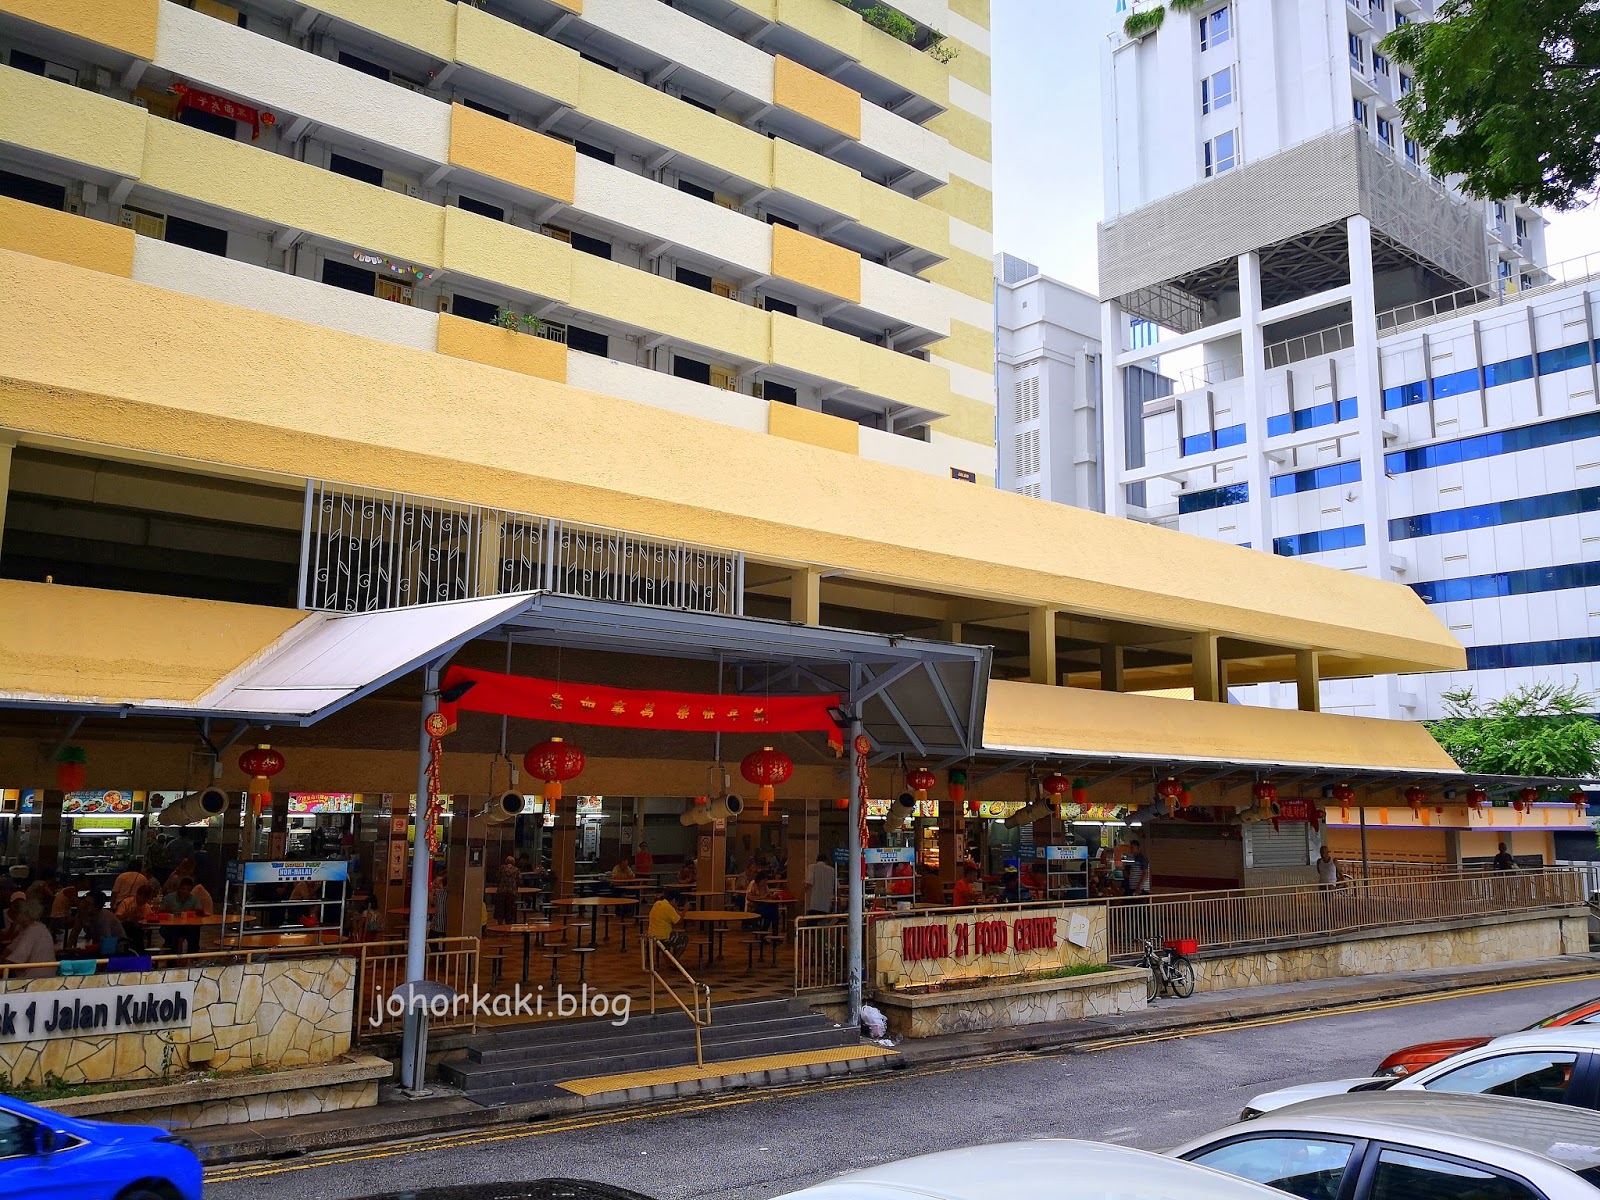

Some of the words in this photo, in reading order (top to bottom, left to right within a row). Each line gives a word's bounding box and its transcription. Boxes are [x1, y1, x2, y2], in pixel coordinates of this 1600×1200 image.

[903, 924, 948, 961] KUKOH
[955, 922, 968, 957] 21
[975, 920, 1008, 955] FOOD
[1014, 916, 1058, 951] CENTRE
[0, 1003, 17, 1035] k
[25, 1001, 36, 1033] 1
[44, 998, 108, 1032] Jalan
[115, 991, 188, 1026] Kukoh
